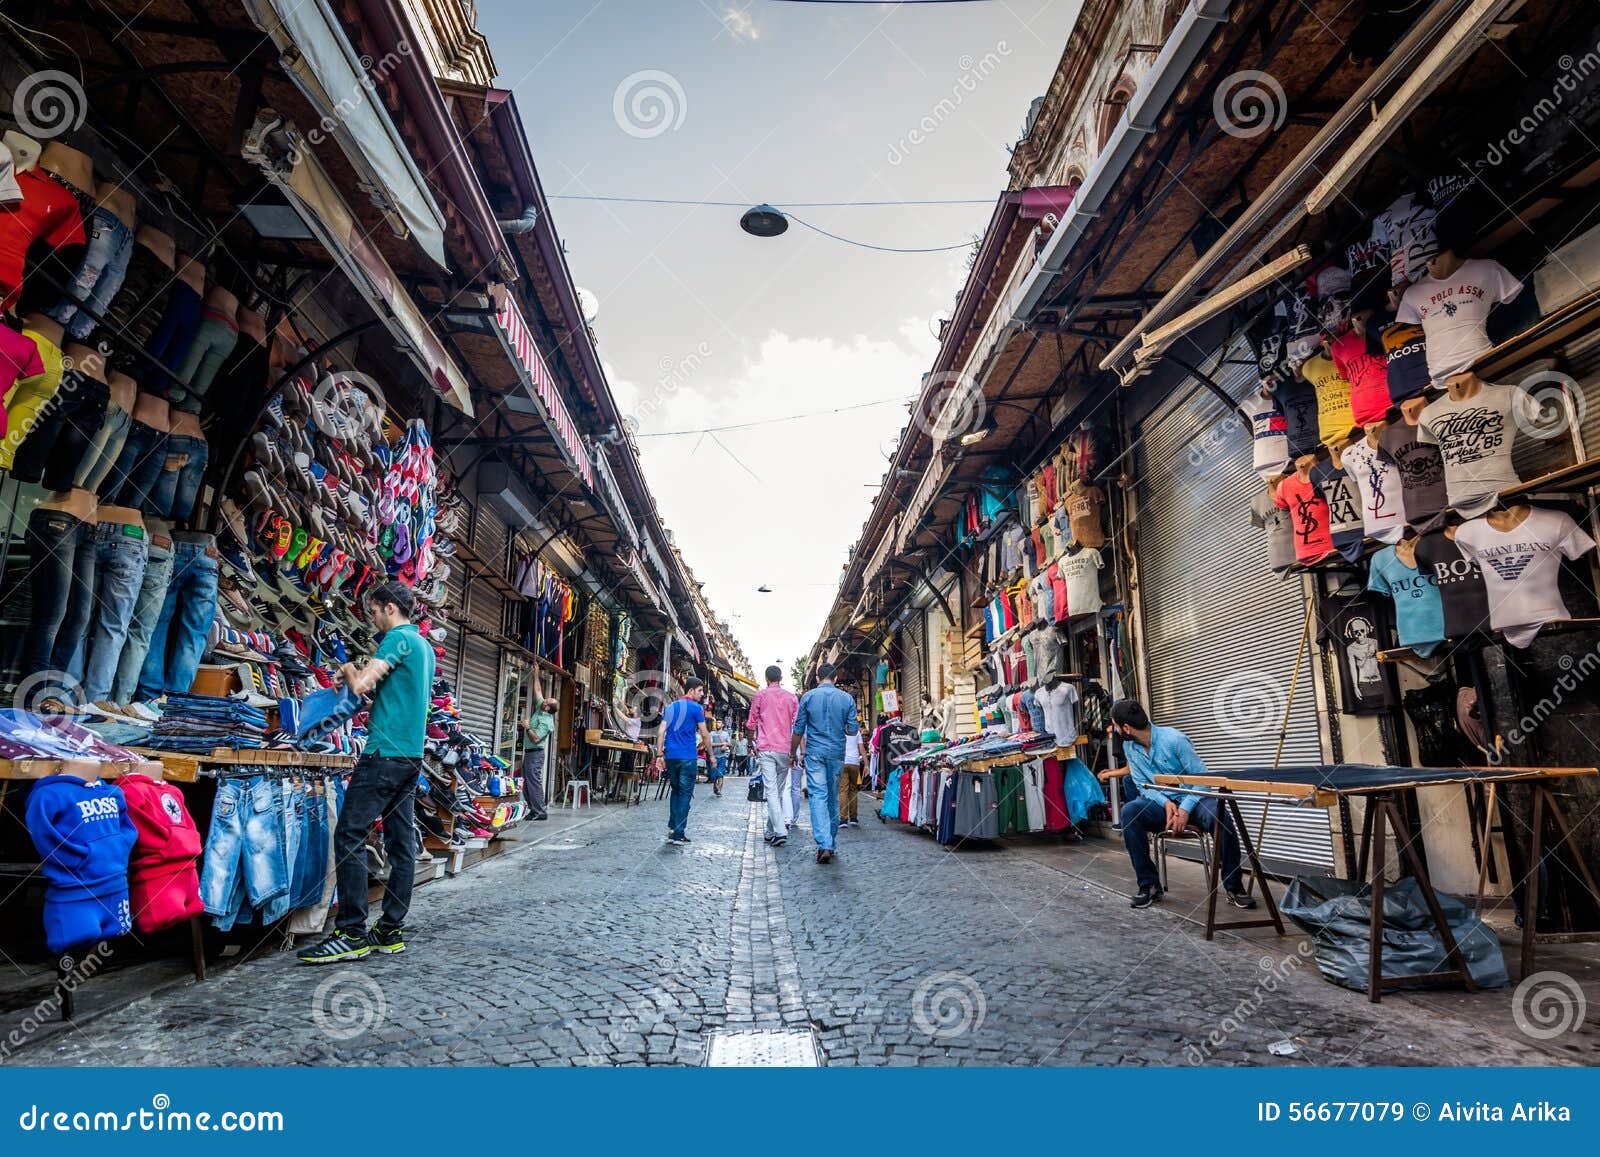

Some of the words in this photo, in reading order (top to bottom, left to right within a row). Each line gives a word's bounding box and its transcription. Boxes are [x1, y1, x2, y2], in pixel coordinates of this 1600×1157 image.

[1431, 287, 1454, 305] POLO
[1386, 342, 1427, 365] ACOST
[1434, 559, 1482, 580] BO
[1391, 574, 1439, 594] GUCC
[76, 797, 120, 819] BOSS
